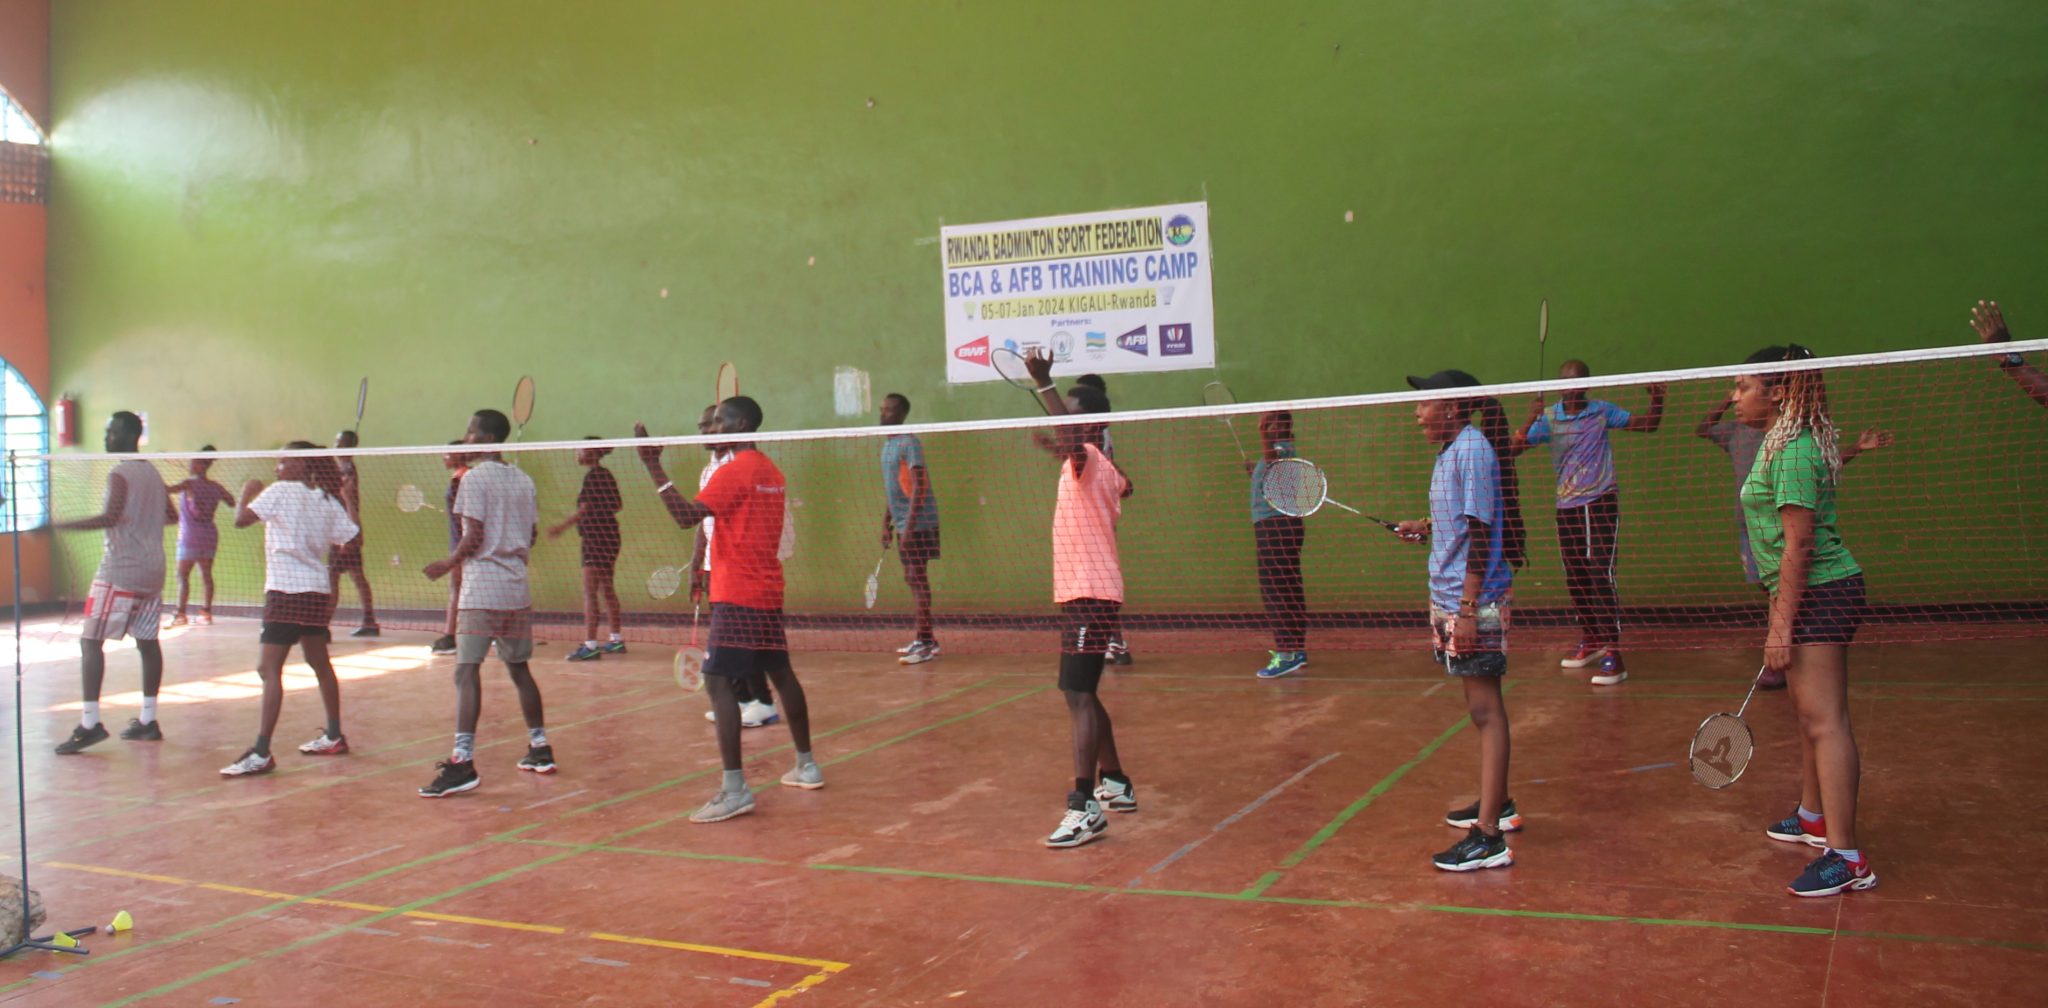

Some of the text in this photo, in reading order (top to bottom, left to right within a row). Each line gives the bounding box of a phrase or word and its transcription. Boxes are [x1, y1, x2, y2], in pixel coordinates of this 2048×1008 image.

[947, 217, 1164, 265] RWANDA BADMINTON SPORT FEDERATION
[949, 251, 1198, 297] BCA & AFB TRAINING CAMP
[981, 289, 1157, 320] 05-07-Jan 2024 KIGALI-Rwanda
[958, 346, 987, 357] BWF
[1124, 335, 1147, 346] AFB
